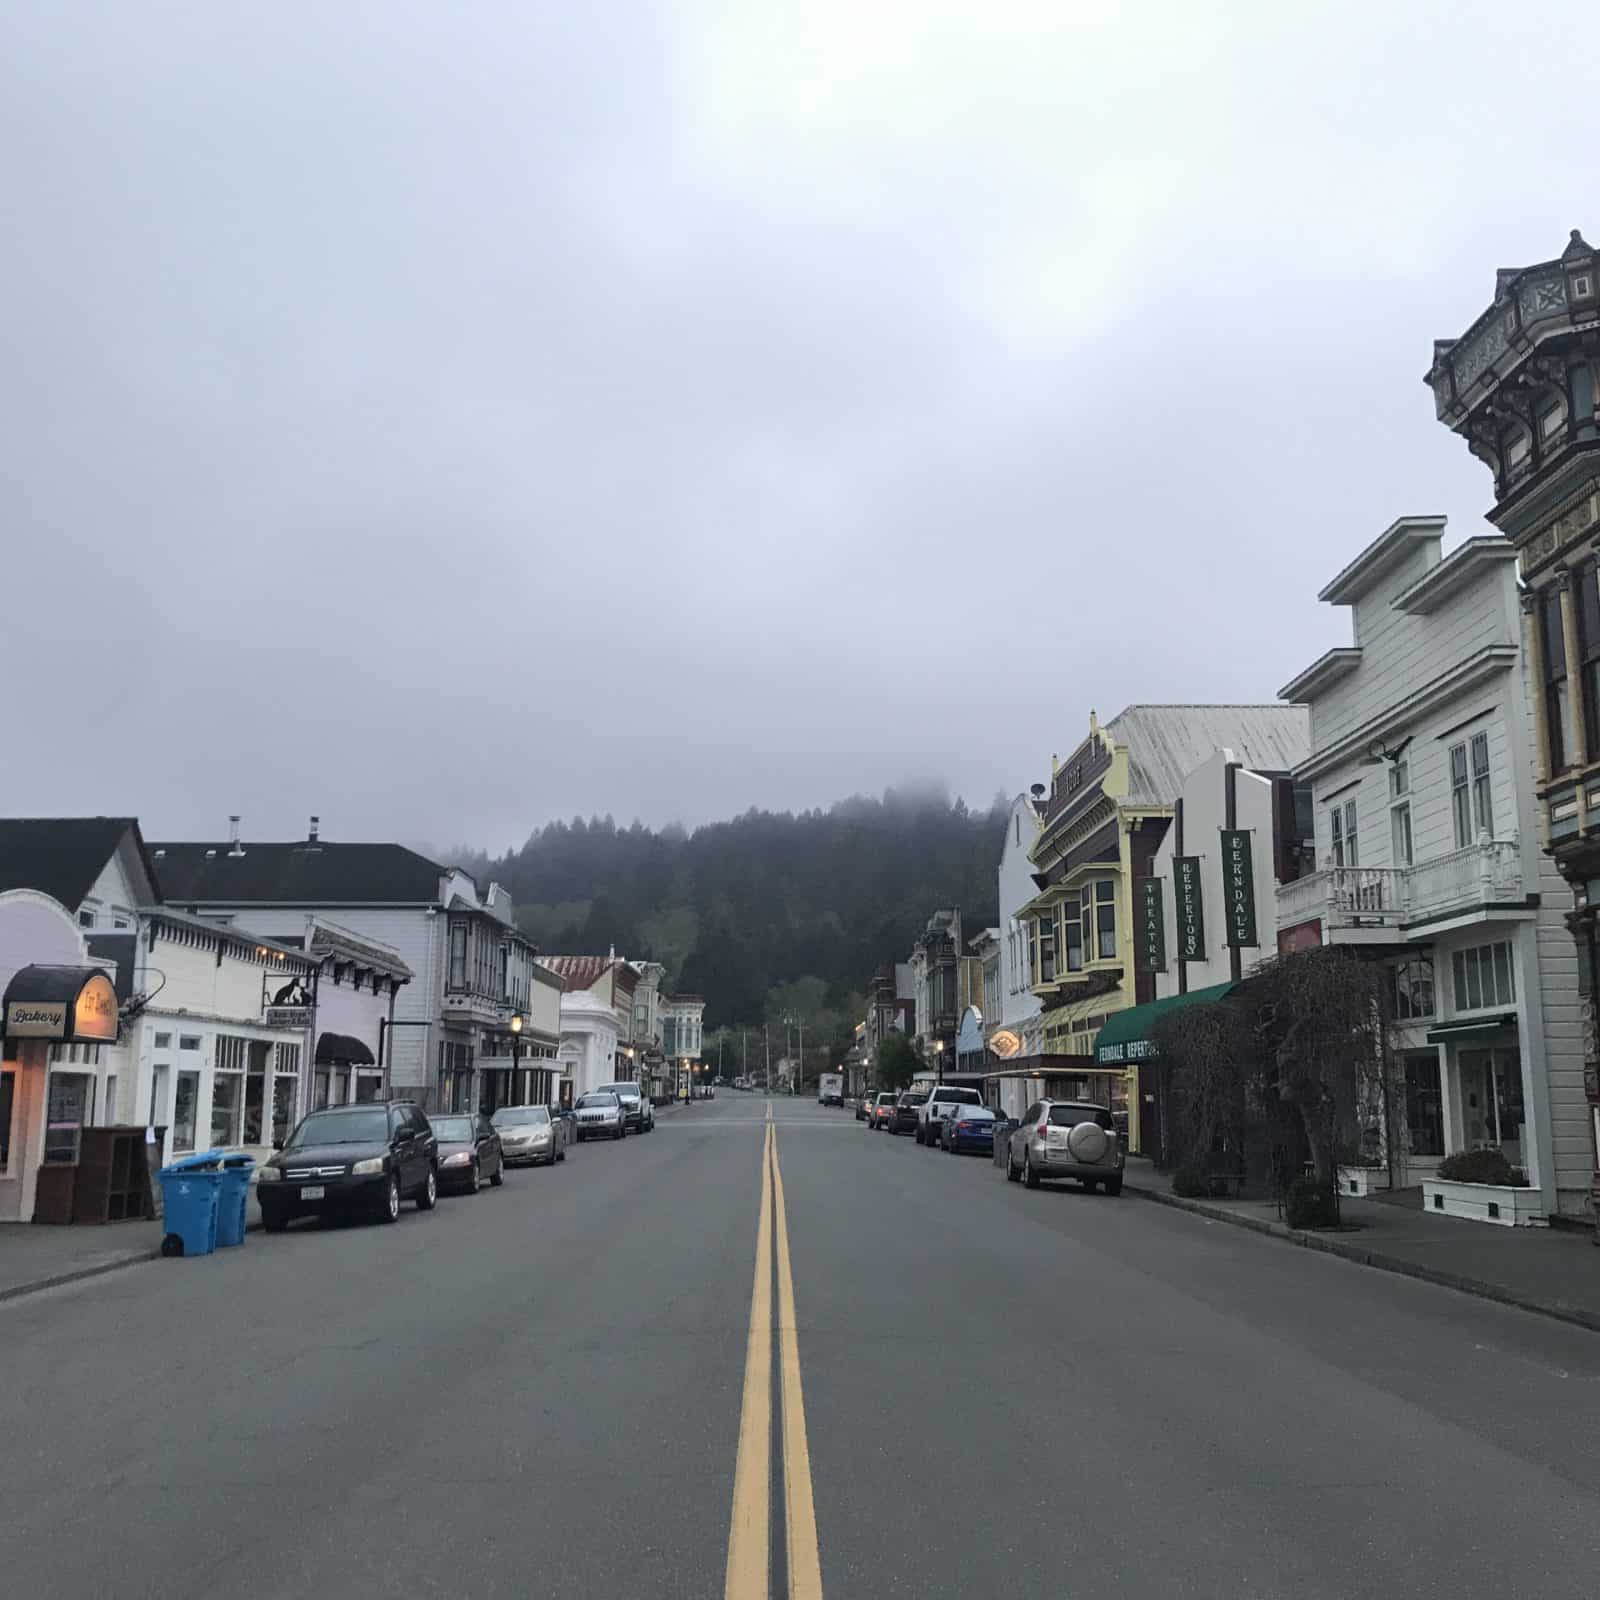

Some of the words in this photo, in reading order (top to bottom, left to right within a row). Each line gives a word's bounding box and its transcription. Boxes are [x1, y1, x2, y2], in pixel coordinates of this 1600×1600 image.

[1144, 884, 1158, 967] THEATRE
[1182, 862, 1197, 956] REPERTORY
[1231, 836, 1248, 940] FERNDALE
[13, 1008, 62, 1026] Bakery
